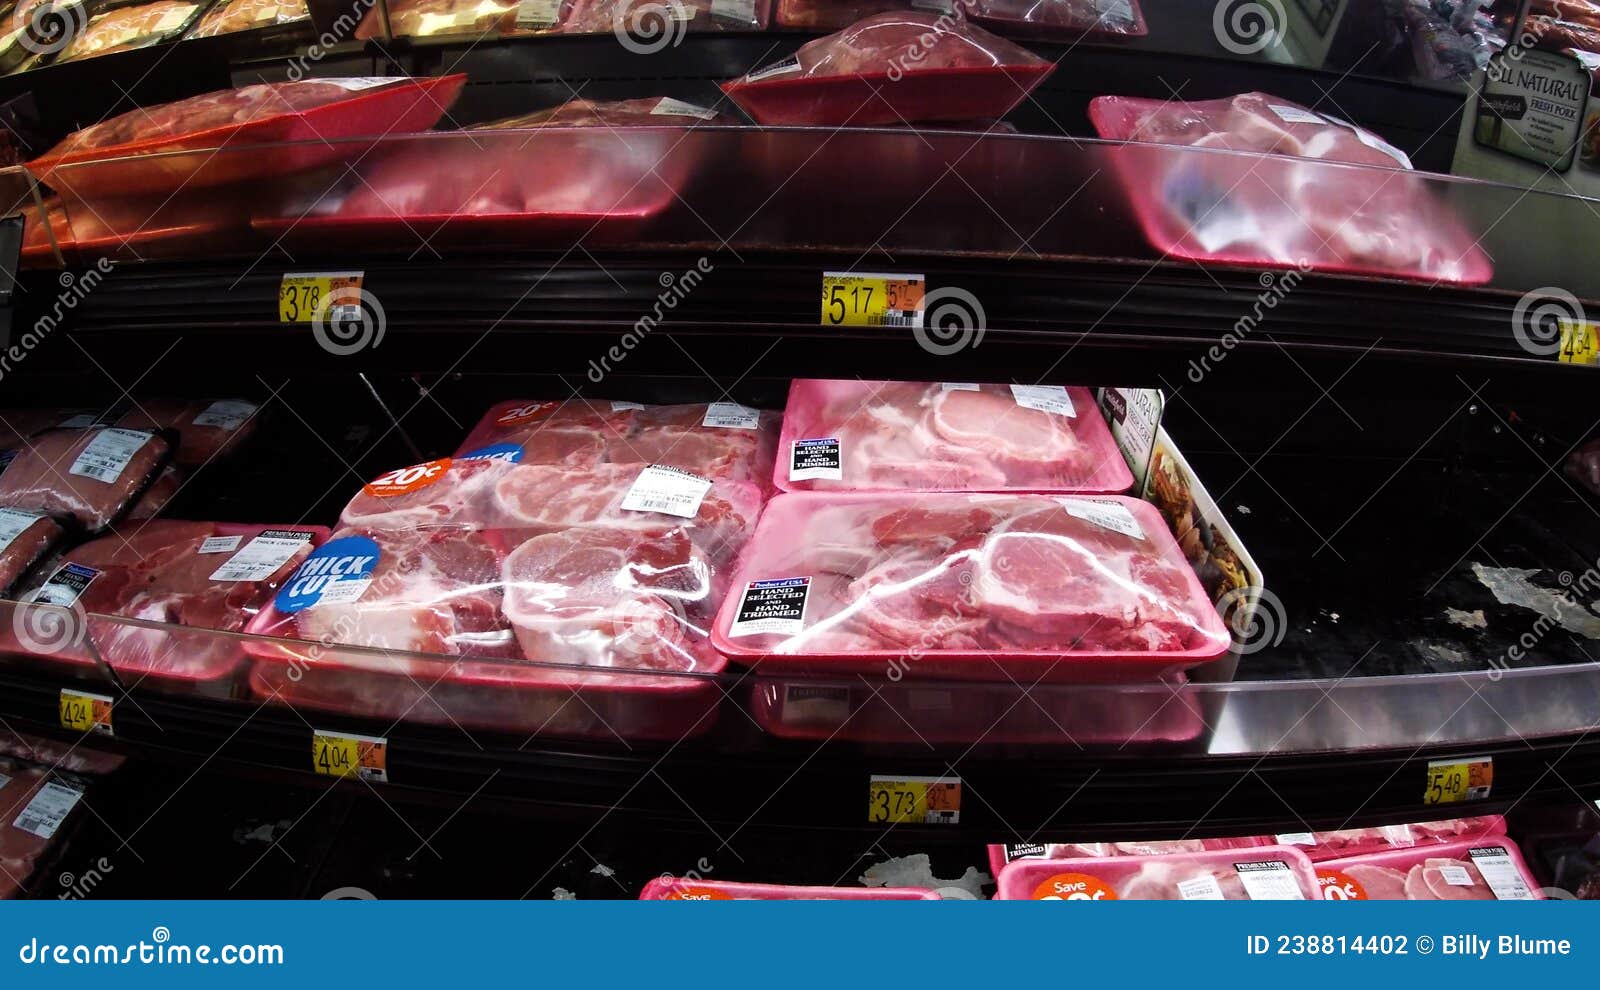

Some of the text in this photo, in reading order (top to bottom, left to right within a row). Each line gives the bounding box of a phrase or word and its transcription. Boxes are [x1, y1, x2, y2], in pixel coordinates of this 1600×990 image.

[1516, 70, 1581, 101] NATURAL
[1530, 99, 1576, 119] FRESH PORK
[760, 587, 795, 595] HAND
[747, 592, 804, 601] SELECTED
[755, 604, 790, 612] HAND
[743, 609, 800, 618] TRIMMED
[1009, 846, 1044, 857] TRIMMED
[1316, 877, 1337, 886] ave
[1054, 882, 1087, 893] Save
